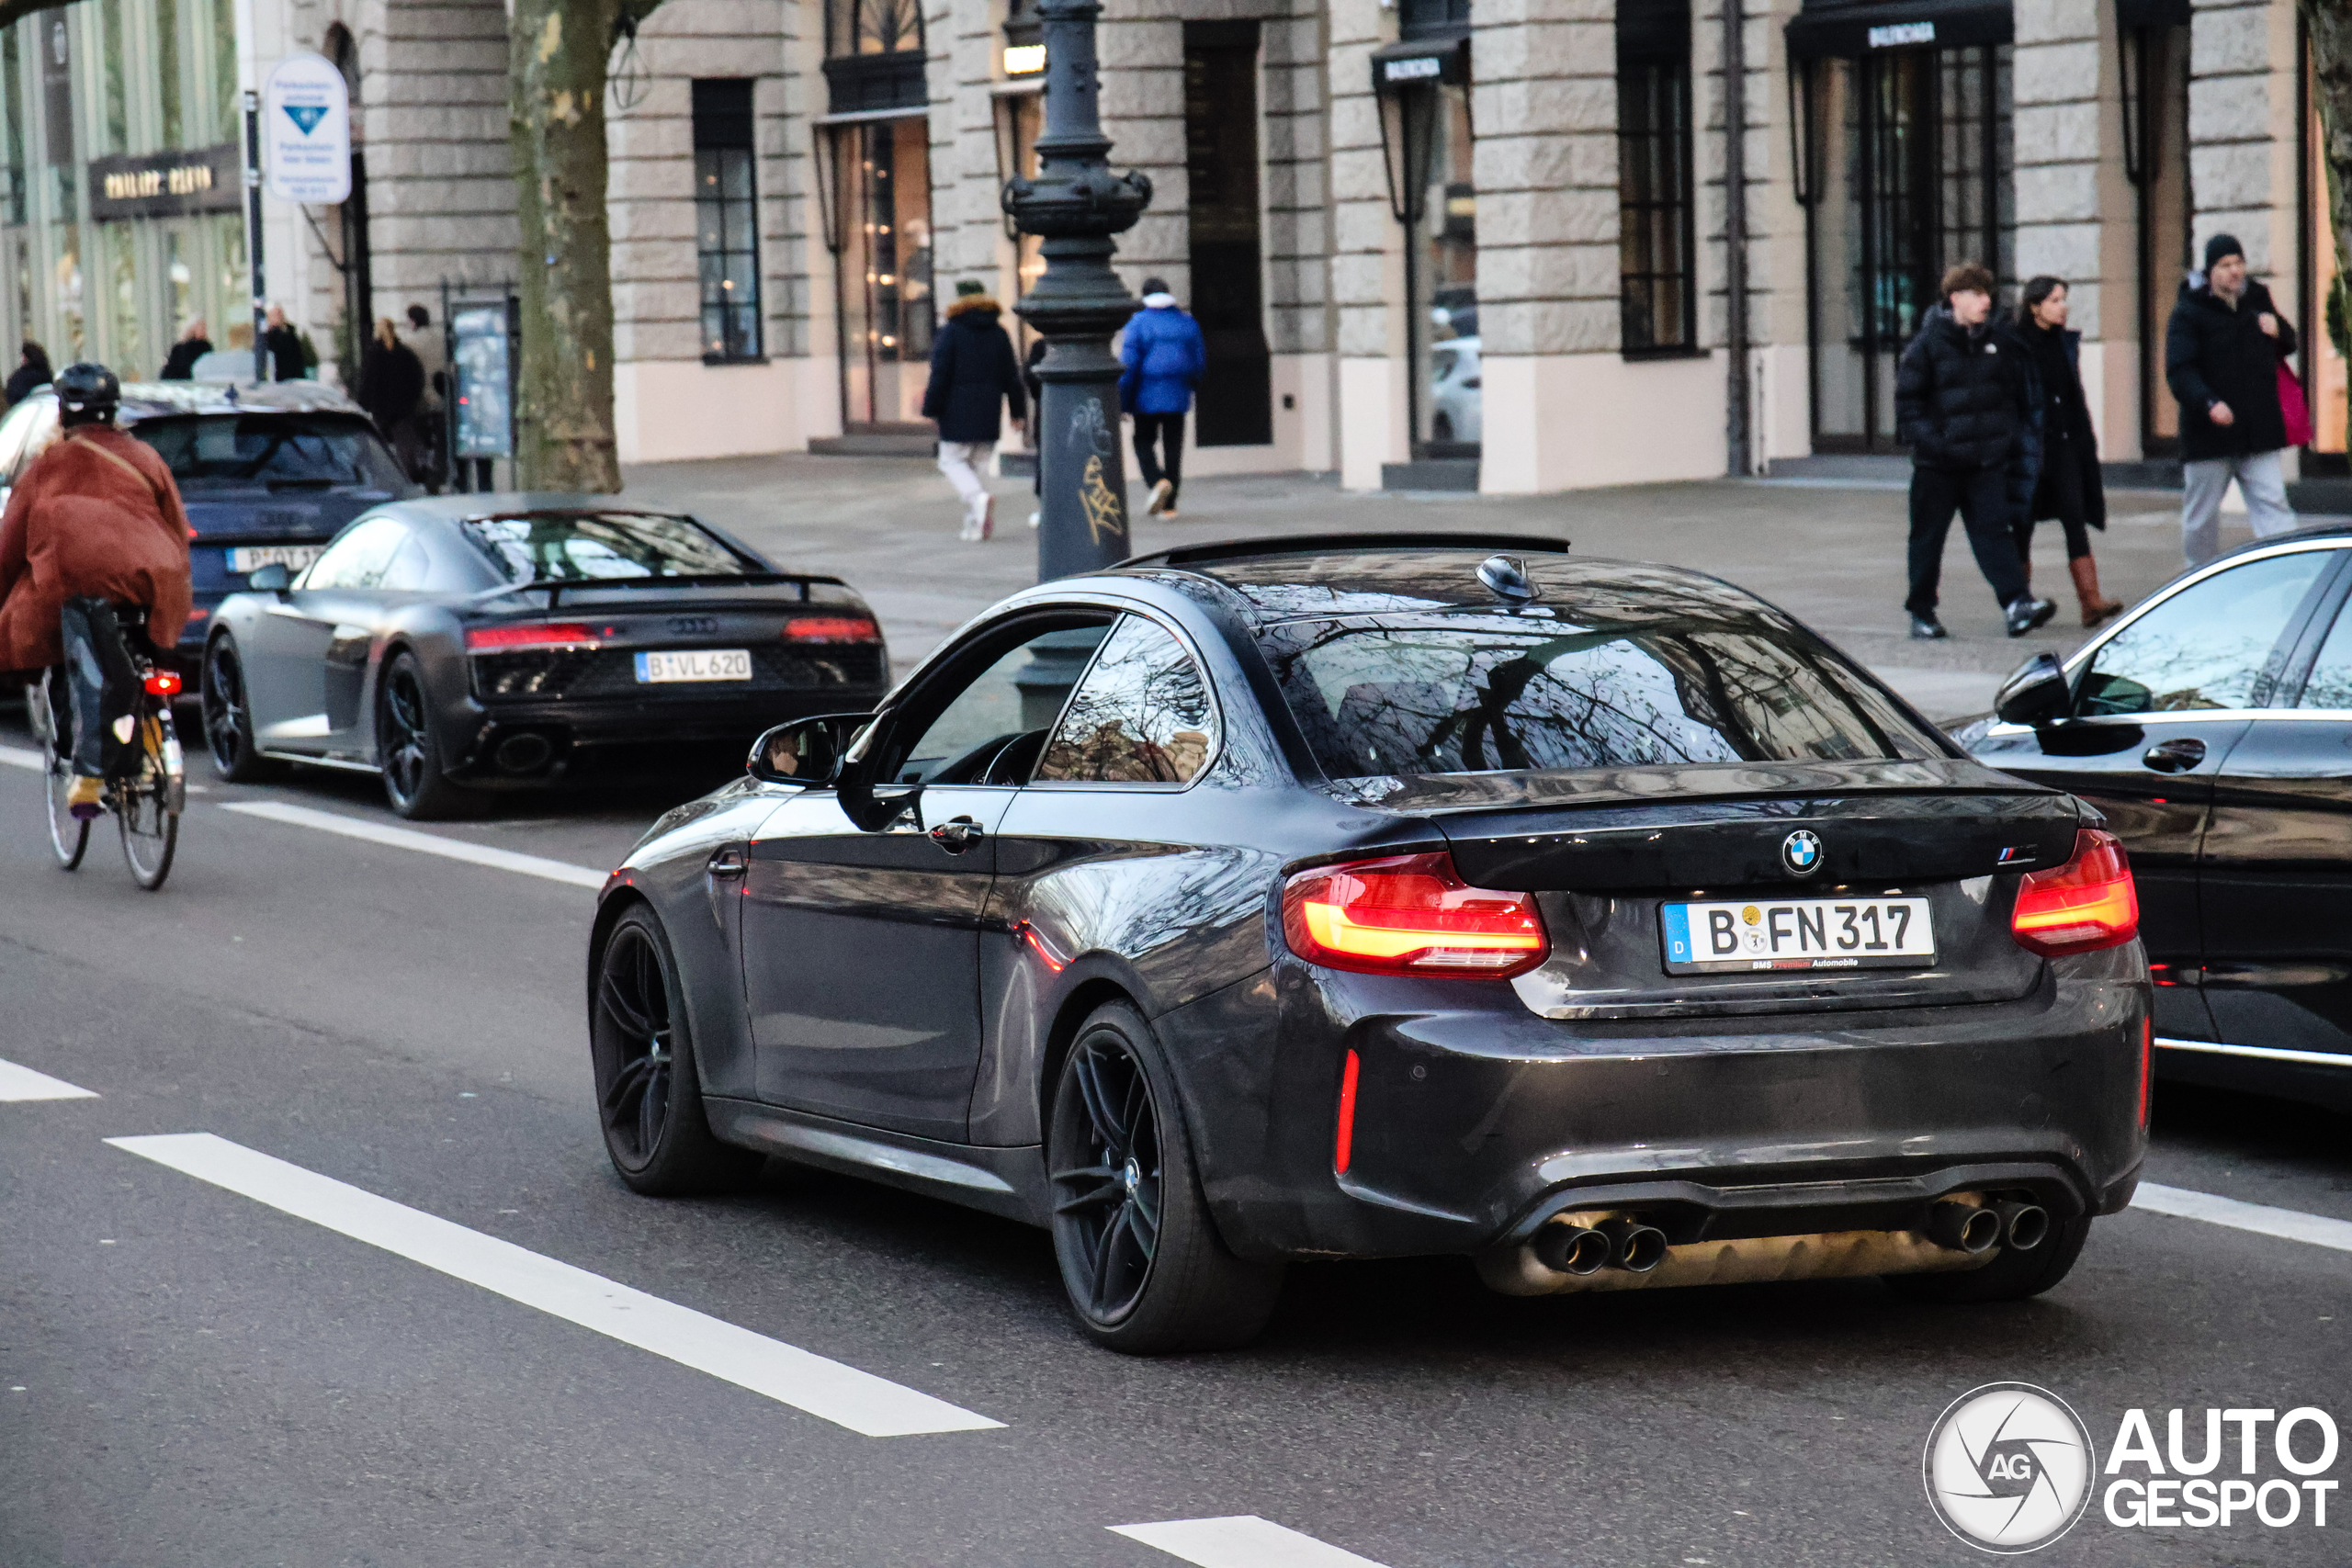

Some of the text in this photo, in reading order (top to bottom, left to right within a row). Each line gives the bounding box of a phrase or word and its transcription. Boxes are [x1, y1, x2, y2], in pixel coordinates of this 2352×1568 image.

[650, 653, 748, 677] B VL 620
[1787, 831, 1820, 846] BMW
[1708, 905, 1911, 954] B FN 317
[1674, 941, 1684, 954] D
[1752, 958, 1859, 969] BMS Premium Automobile
